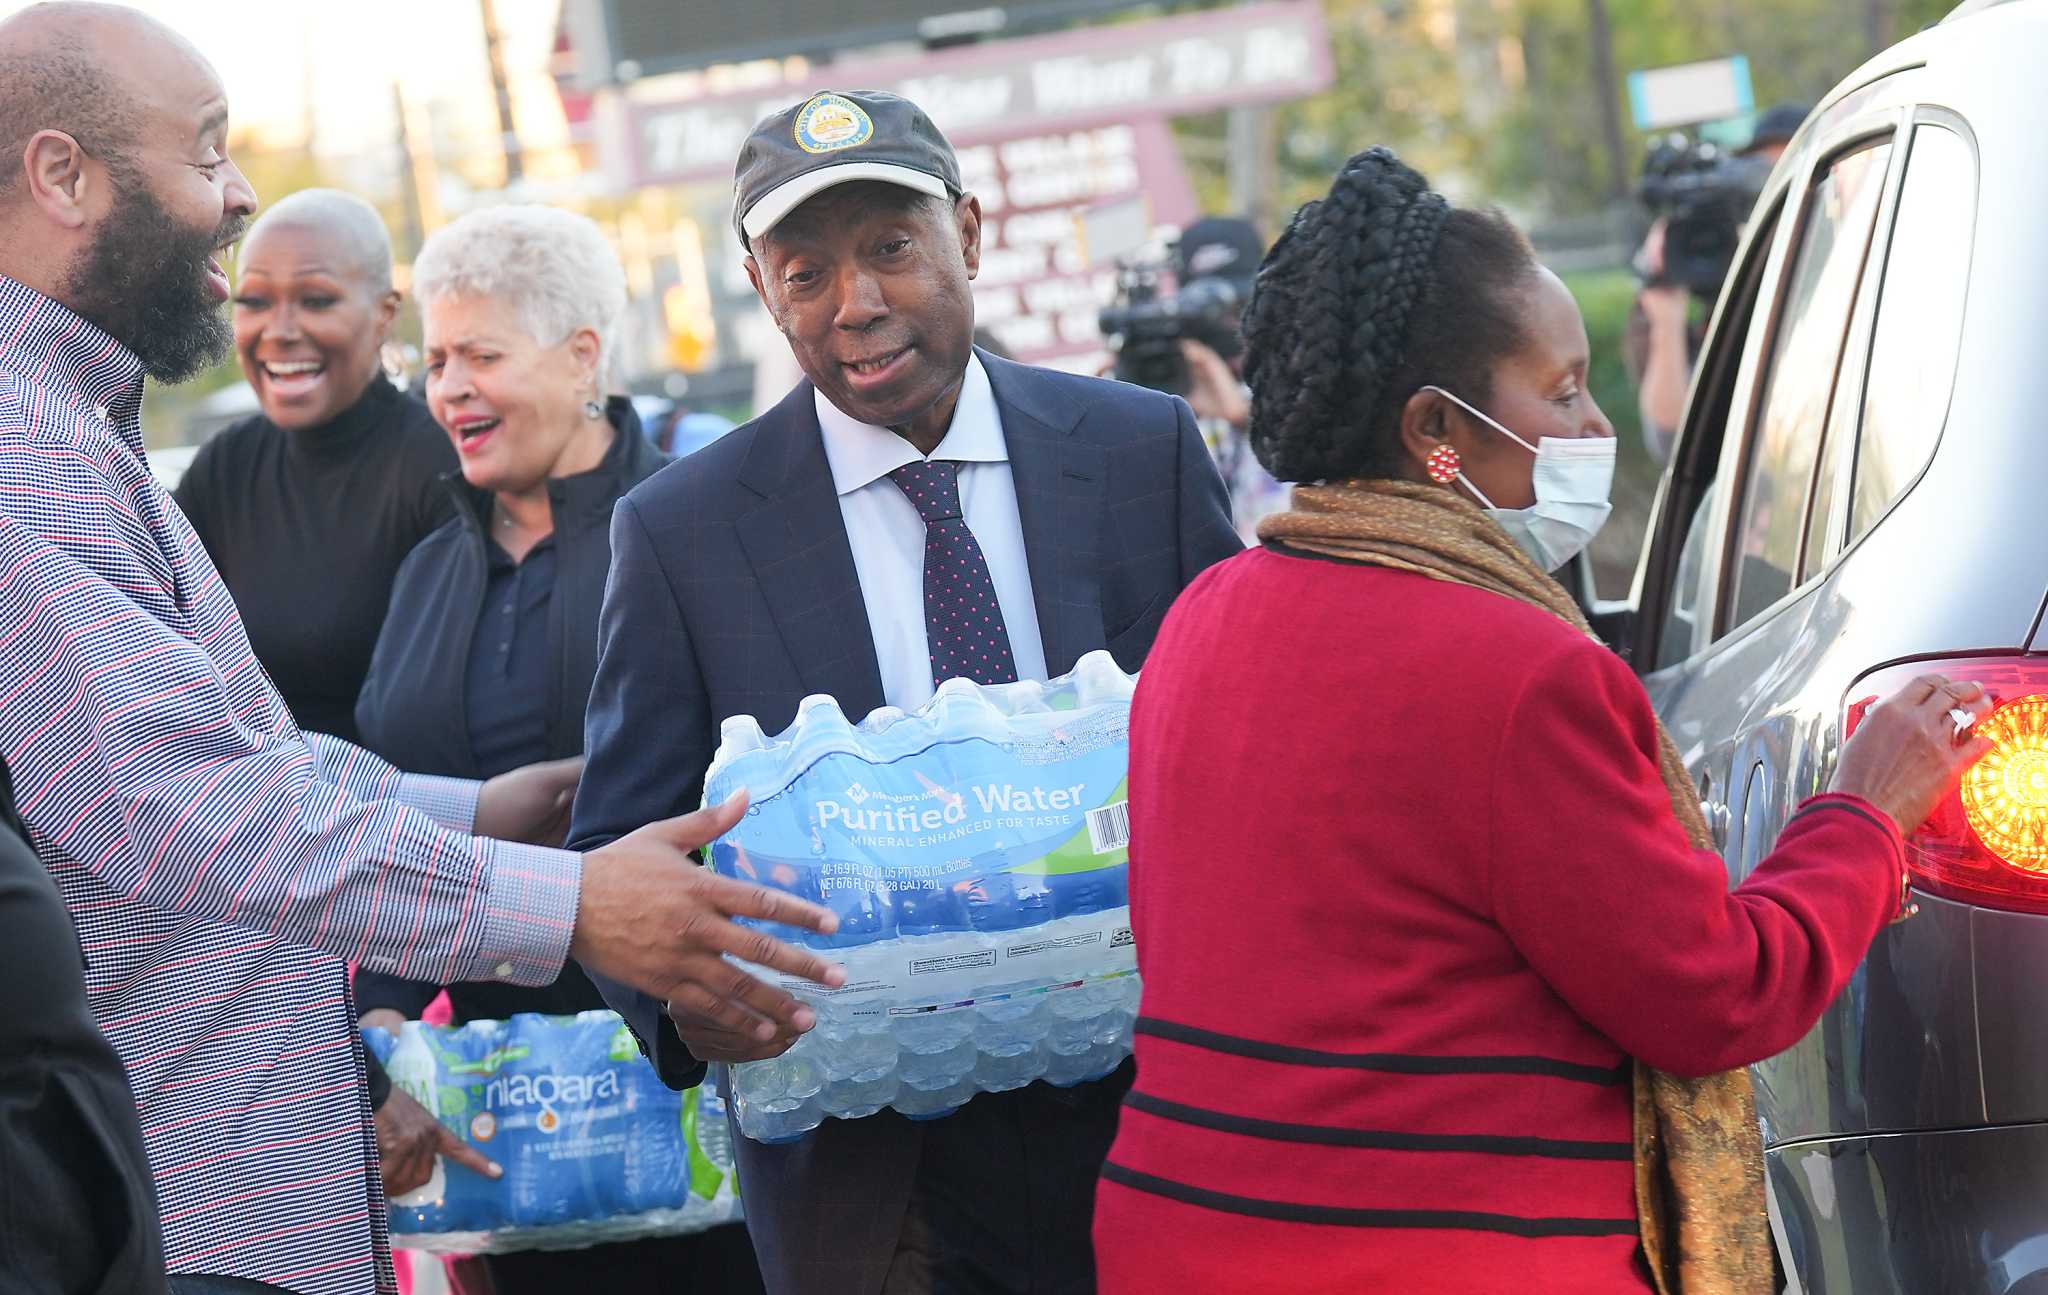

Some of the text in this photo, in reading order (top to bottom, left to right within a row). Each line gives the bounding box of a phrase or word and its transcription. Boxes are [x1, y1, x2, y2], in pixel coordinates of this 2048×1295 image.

[815, 782, 1086, 832] Purified Water
[848, 813, 1072, 848] MINERAL ENHANCED FOR TASTE
[836, 877, 852, 889] 676
[922, 880, 935, 890] 20
[851, 864, 862, 876] FL
[486, 1068, 621, 1133] niagara
